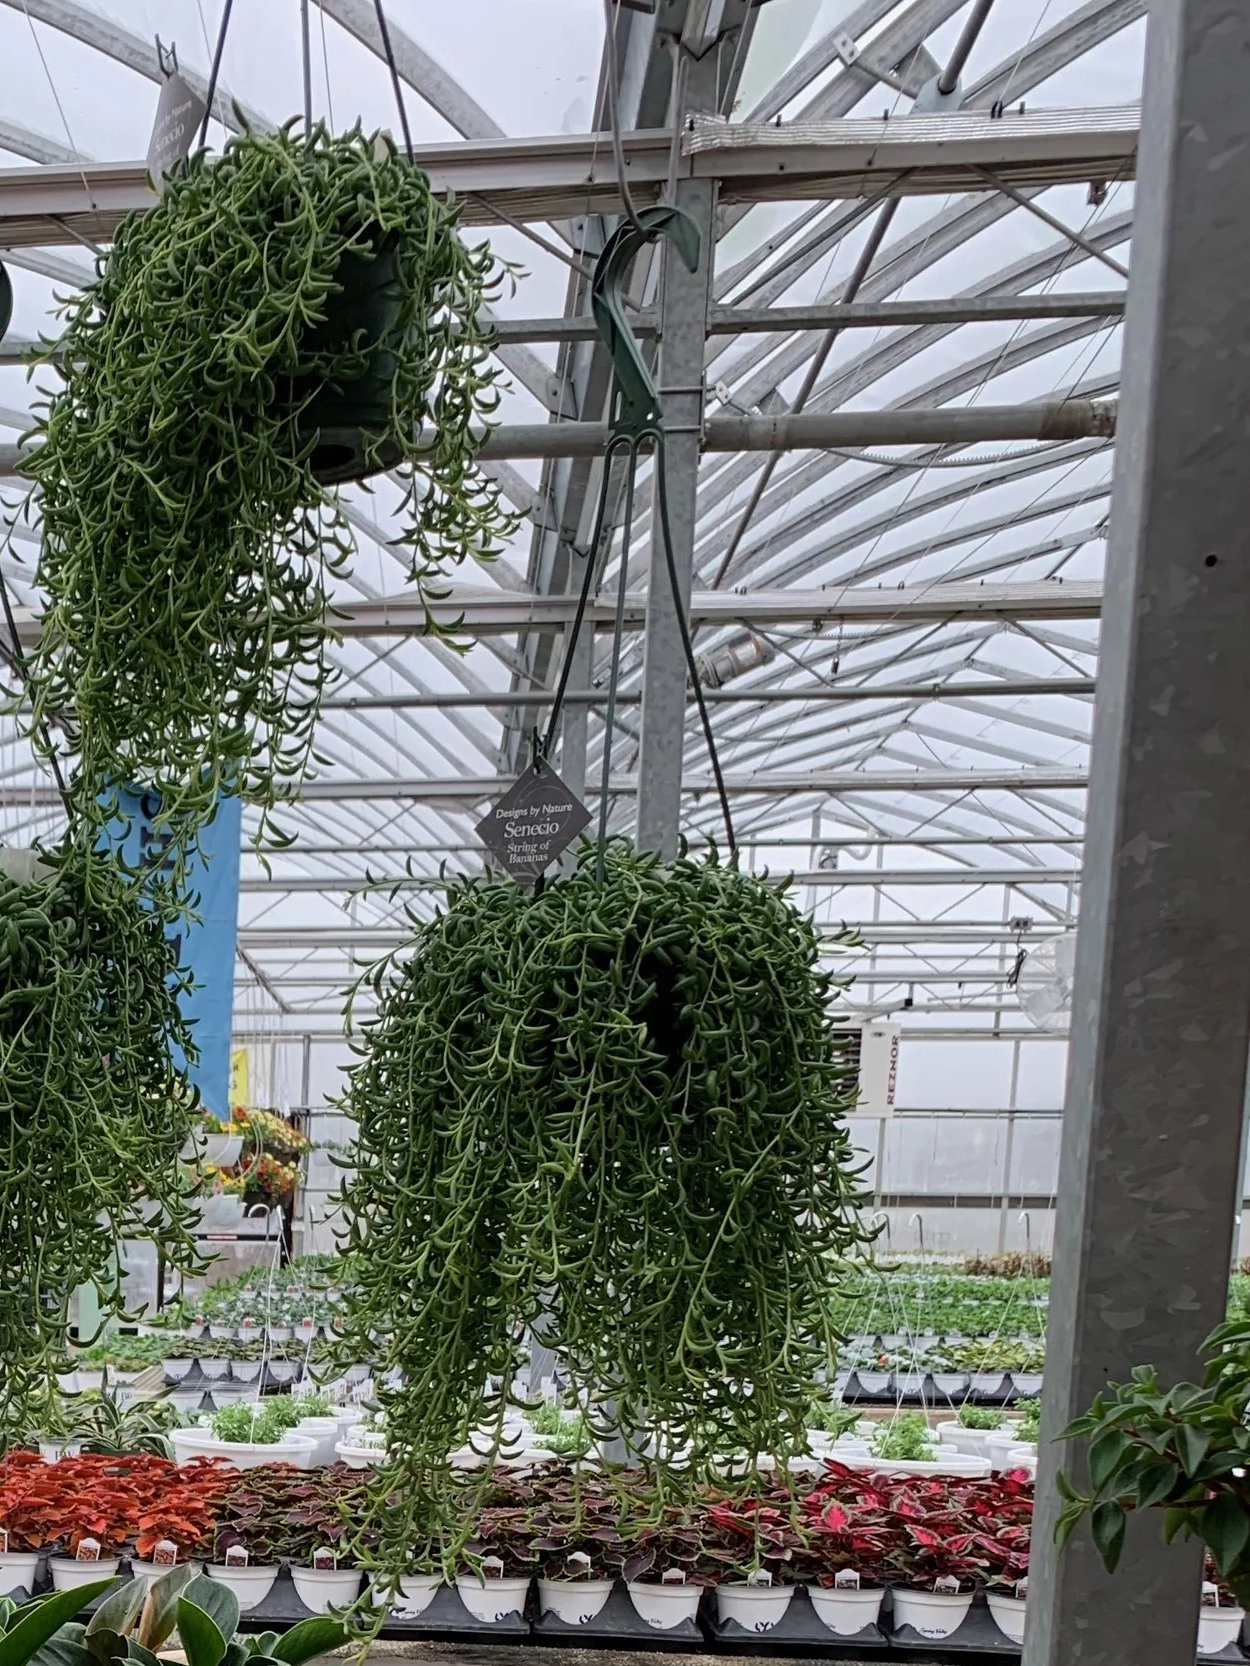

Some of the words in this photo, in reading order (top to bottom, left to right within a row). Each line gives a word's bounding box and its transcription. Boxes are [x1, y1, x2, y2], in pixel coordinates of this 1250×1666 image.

[495, 807, 528, 819] Designs
[529, 805, 540, 817] by
[542, 803, 573, 814] Nature
[503, 817, 560, 838] Senecio
[507, 842, 538, 854] String
[539, 839, 552, 851] of
[509, 853, 549, 864] Bananas
[886, 1034, 900, 1105] REZNOR
